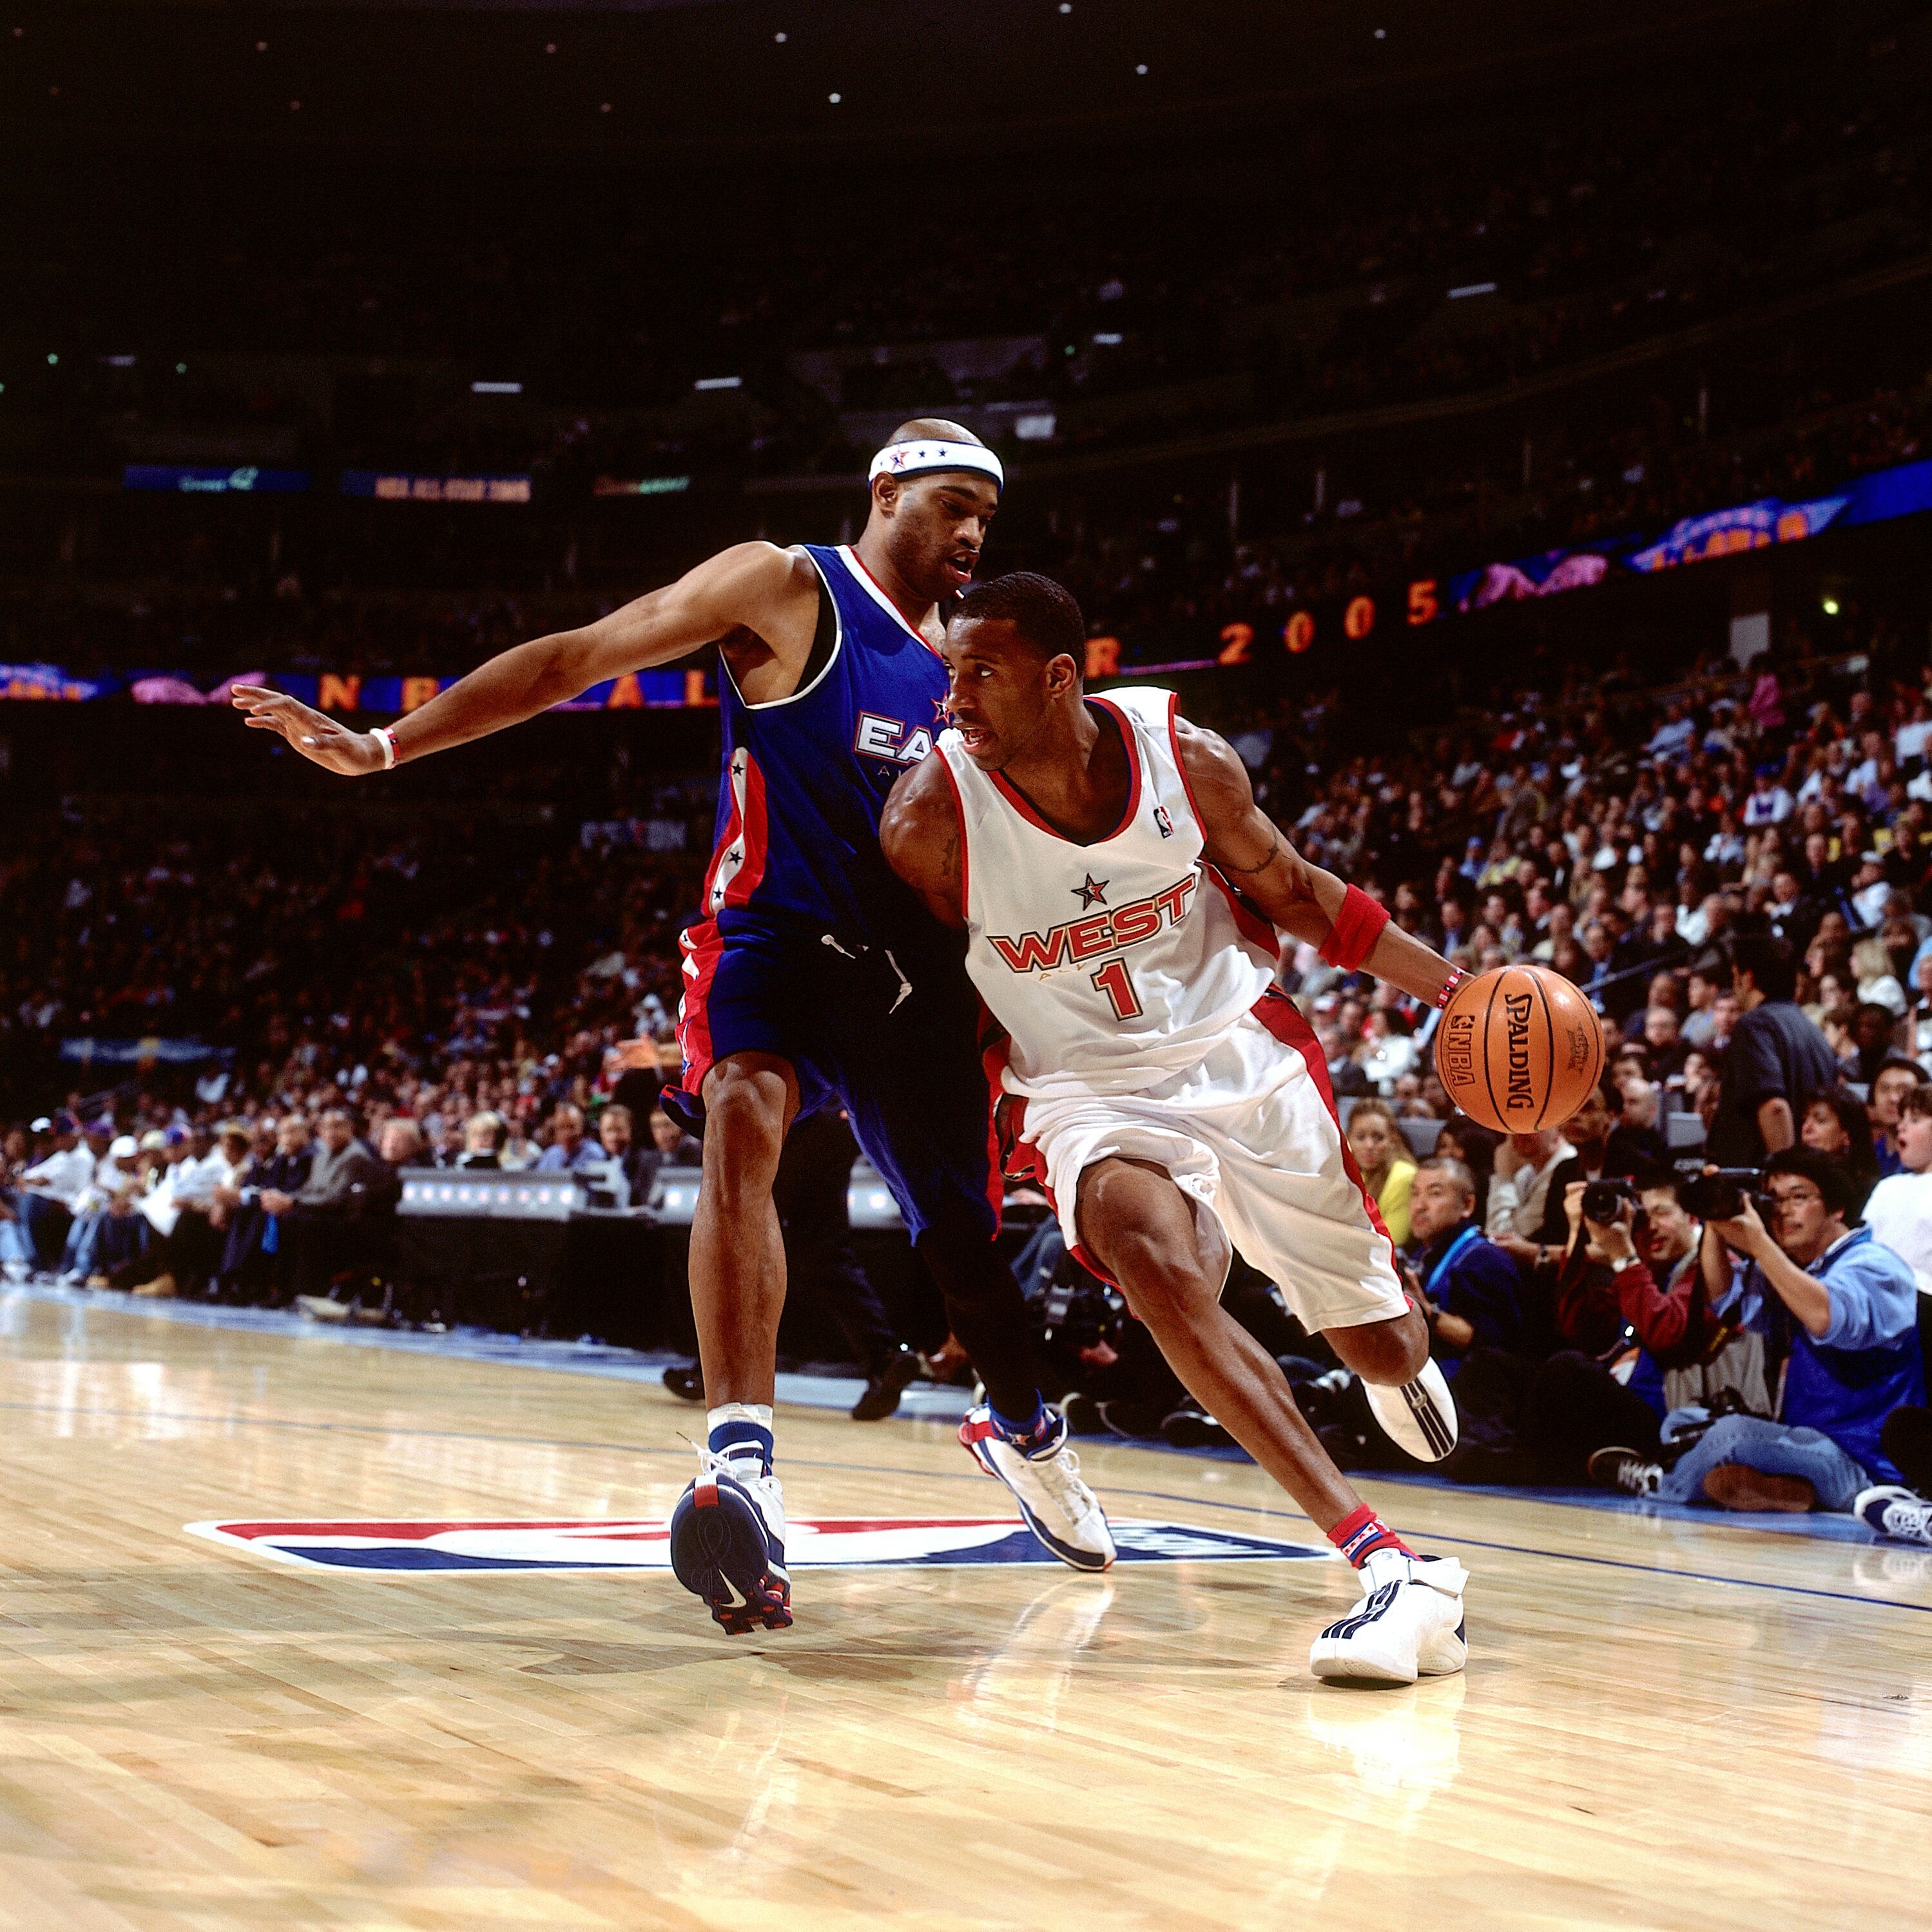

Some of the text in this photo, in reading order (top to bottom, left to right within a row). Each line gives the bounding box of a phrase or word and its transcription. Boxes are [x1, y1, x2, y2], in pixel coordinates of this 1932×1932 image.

[1218, 578, 1439, 666] 2005
[987, 873, 1196, 973] WEST
[1090, 957, 1143, 1021] 1
[1448, 1032, 1476, 1087] NBA
[1504, 992, 1534, 1112] SPALDING
